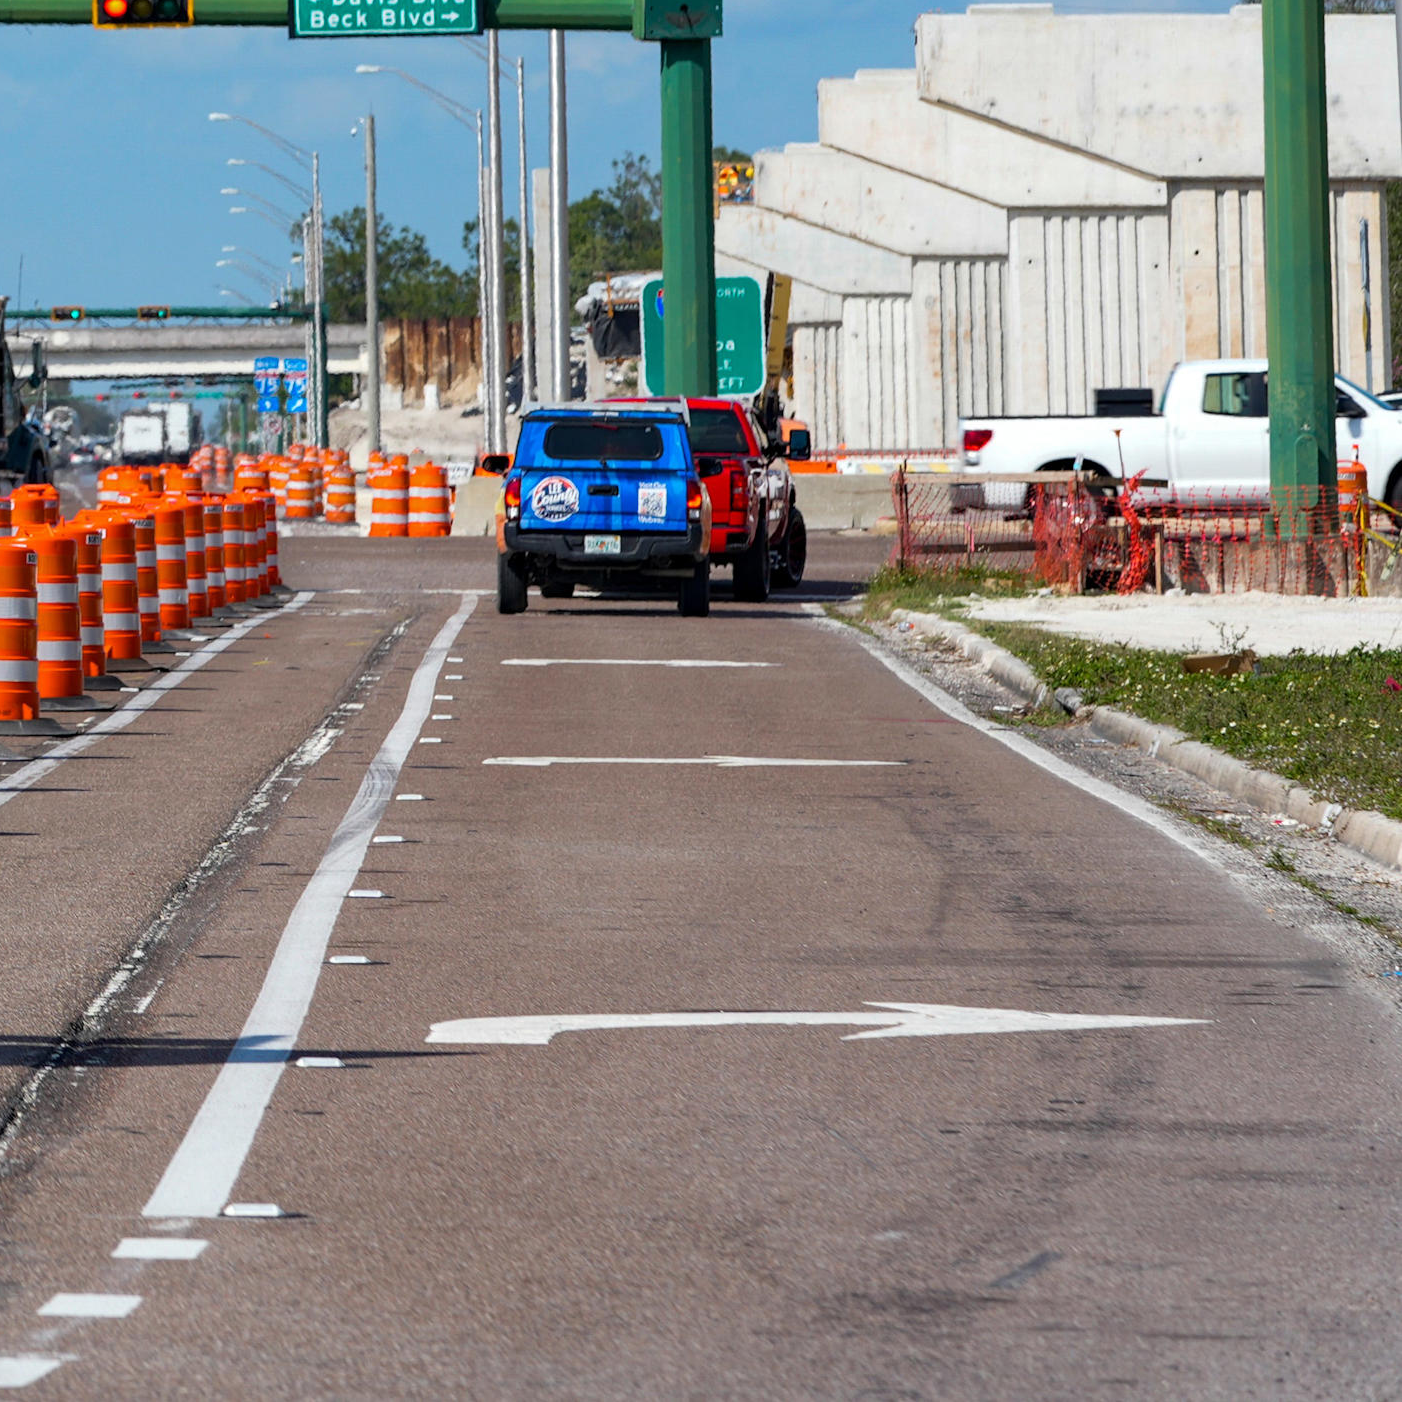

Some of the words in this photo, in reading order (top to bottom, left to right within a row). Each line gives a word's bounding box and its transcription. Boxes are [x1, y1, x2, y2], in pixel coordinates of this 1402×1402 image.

[310, 9, 367, 28] Beck
[381, 8, 435, 27] Blvd
[716, 287, 746, 298] ORTH
[719, 377, 745, 390] EFT
